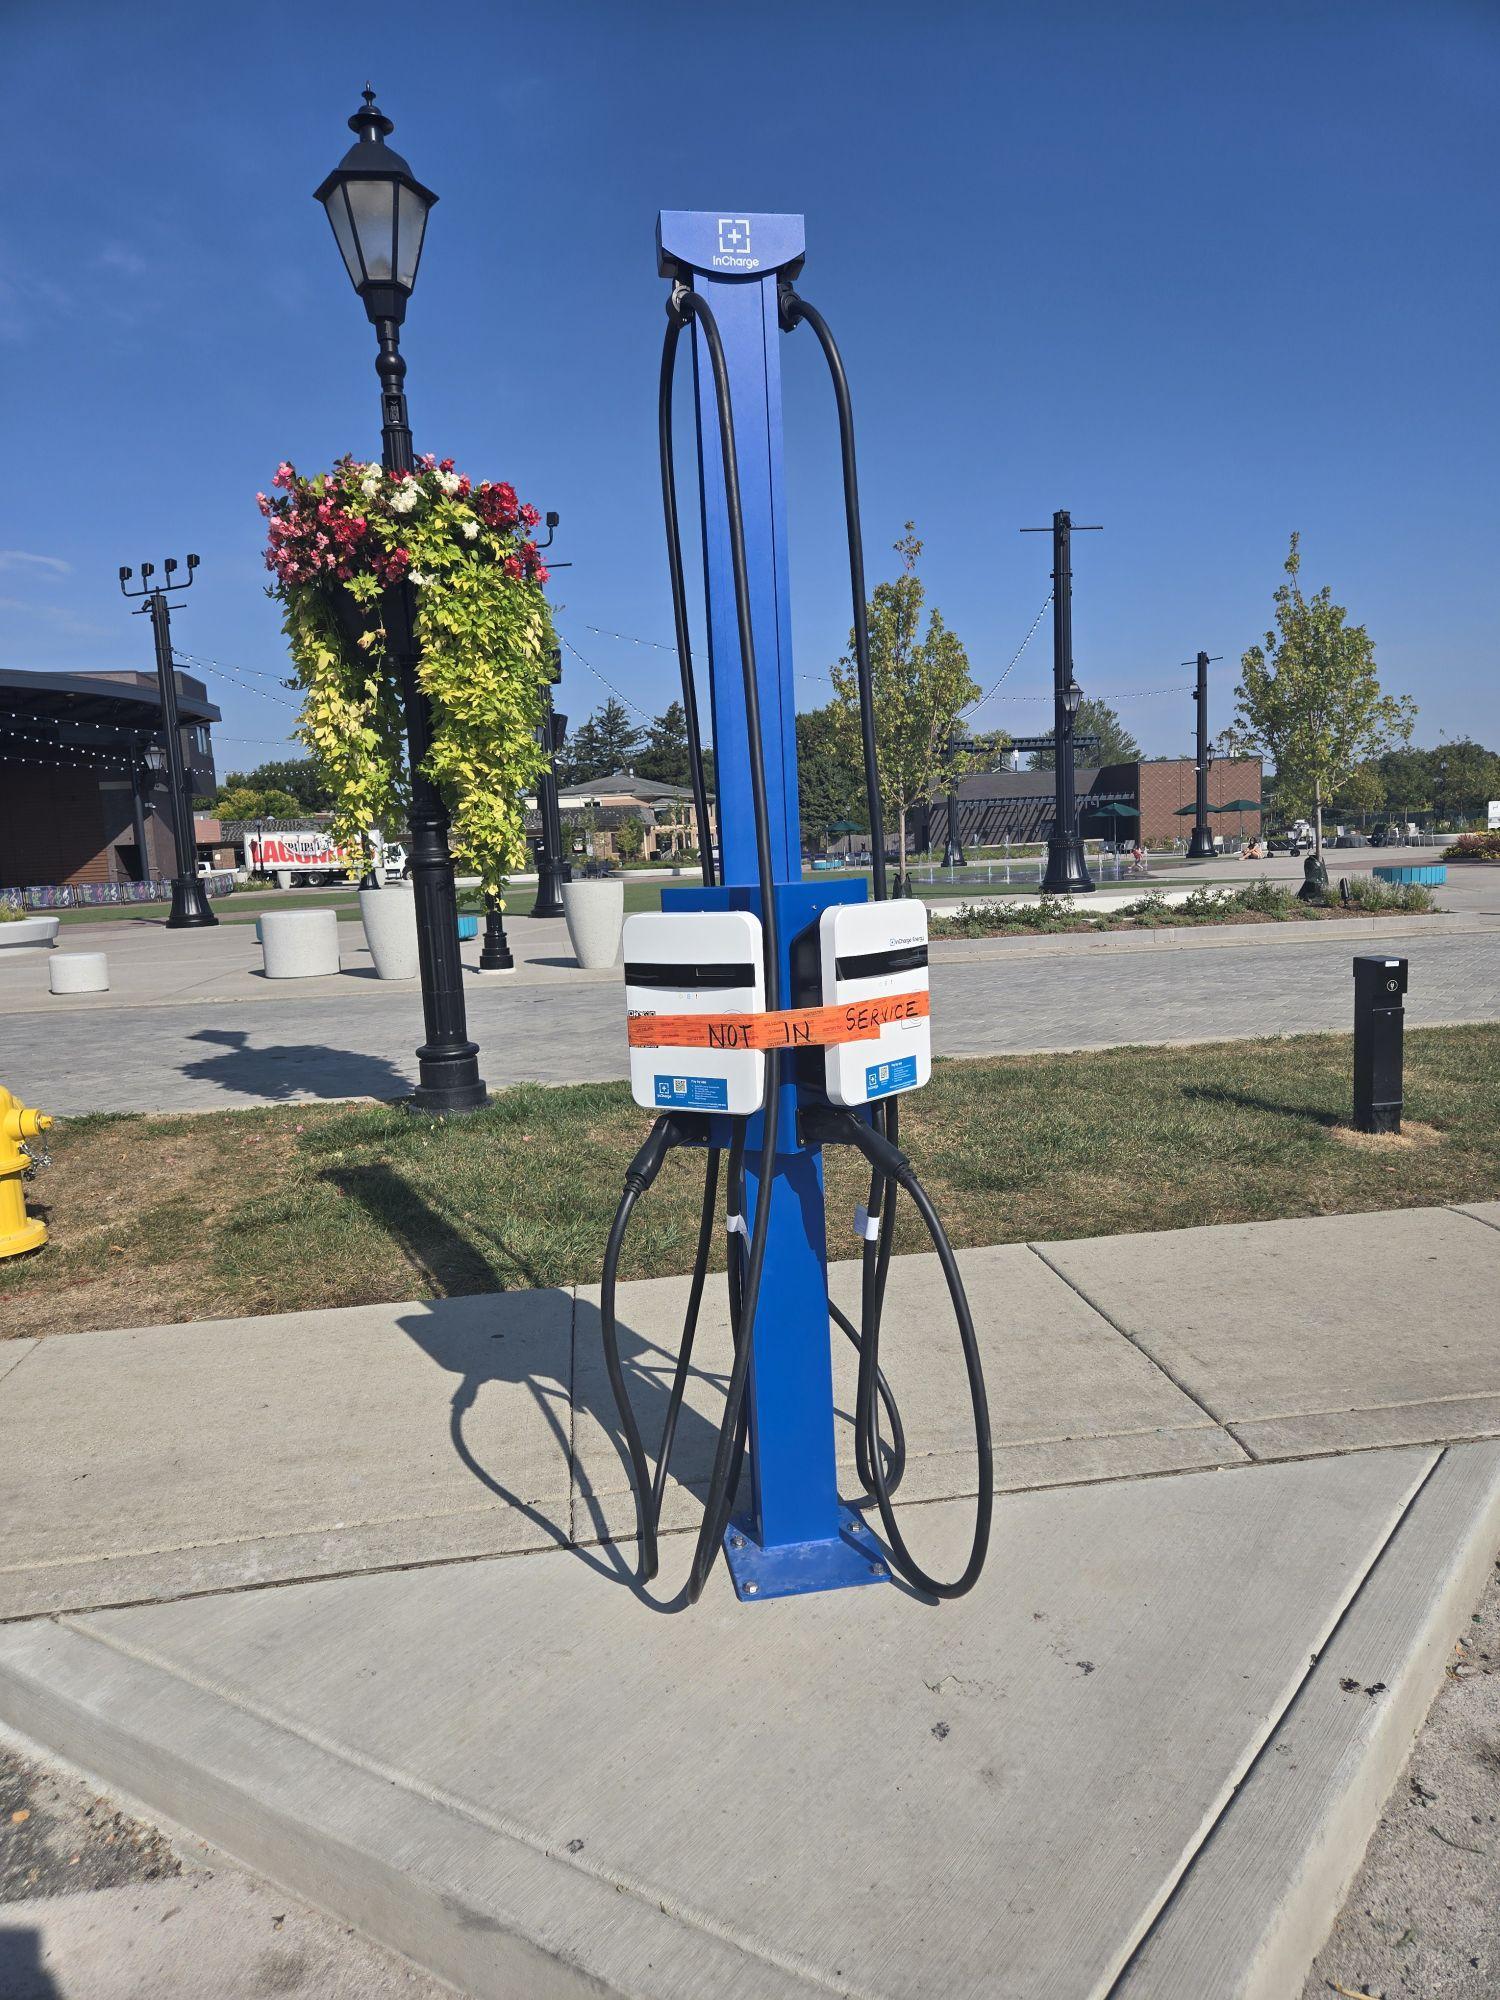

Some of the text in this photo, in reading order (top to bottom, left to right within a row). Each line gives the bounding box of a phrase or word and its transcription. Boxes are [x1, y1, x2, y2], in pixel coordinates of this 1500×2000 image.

[713, 255, 760, 270] InCharge
[708, 1024, 752, 1048] NOT
[783, 1021, 811, 1043] IN
[846, 1000, 919, 1031] SERVICE
